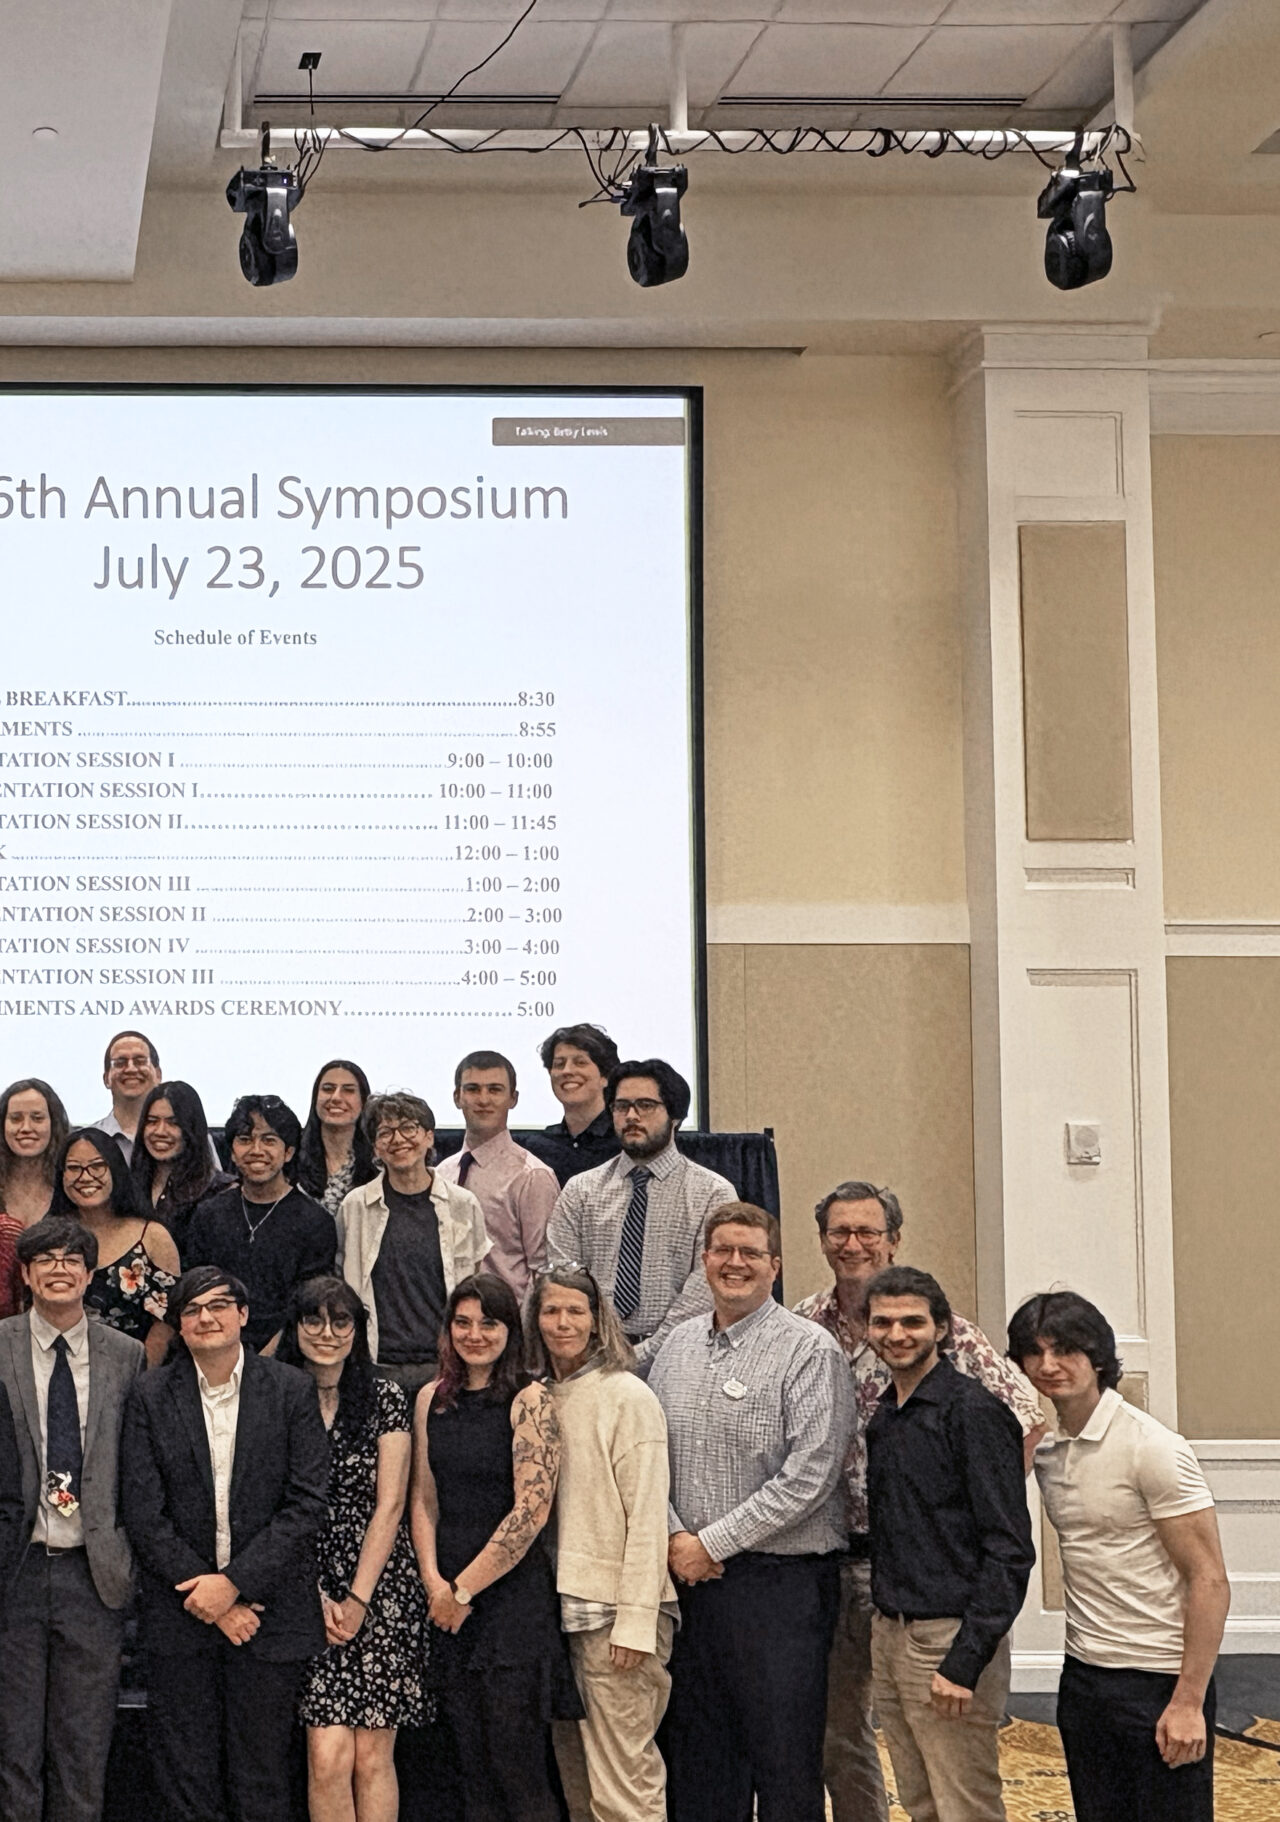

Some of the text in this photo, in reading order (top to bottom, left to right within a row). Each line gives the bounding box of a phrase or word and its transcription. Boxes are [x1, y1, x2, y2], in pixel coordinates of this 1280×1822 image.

[83, 472, 259, 520] Annual
[276, 472, 568, 531] Symposium
[93, 542, 425, 601] July 23, 2025
[154, 629, 318, 646] Schedule of Events
[5, 690, 128, 707] BREAKFAST
[517, 691, 555, 707] 8:30
[519, 721, 556, 738] 8:55
[75, 751, 162, 768] SESSION
[168, 751, 175, 768] I
[447, 752, 485, 769] 9:00
[507, 752, 553, 769] 10:00
[99, 782, 186, 799] SESSION
[191, 782, 199, 799] I
[439, 783, 486, 800] 10:00
[508, 783, 553, 800] 11:00
[75, 813, 162, 830] SESSION
[168, 813, 184, 830] II
[445, 814, 490, 831] 11:00
[511, 814, 557, 831] 11:45
[455, 845, 502, 861] 12:00
[523, 845, 560, 861] 1:00
[75, 875, 162, 892] SESSION
[167, 875, 191, 892] III
[466, 876, 503, 893] 1:00
[523, 876, 561, 893] 2:00
[99, 906, 186, 923] SESSION
[191, 906, 206, 923] II
[466, 907, 504, 924] 2:00
[524, 907, 563, 924] 3:00
[75, 937, 162, 954] SESSION
[168, 937, 191, 954] IV
[463, 938, 502, 955] 3:00
[522, 938, 560, 955] 4:00
[99, 968, 186, 985] SESSION
[191, 968, 214, 985] III
[460, 969, 499, 986] 4:00
[519, 969, 557, 986] 5:00
[79, 999, 125, 1016] AND
[128, 999, 216, 1016] AWARDS
[220, 999, 343, 1016] CEREMONY
[516, 1001, 555, 1017] 5:00
